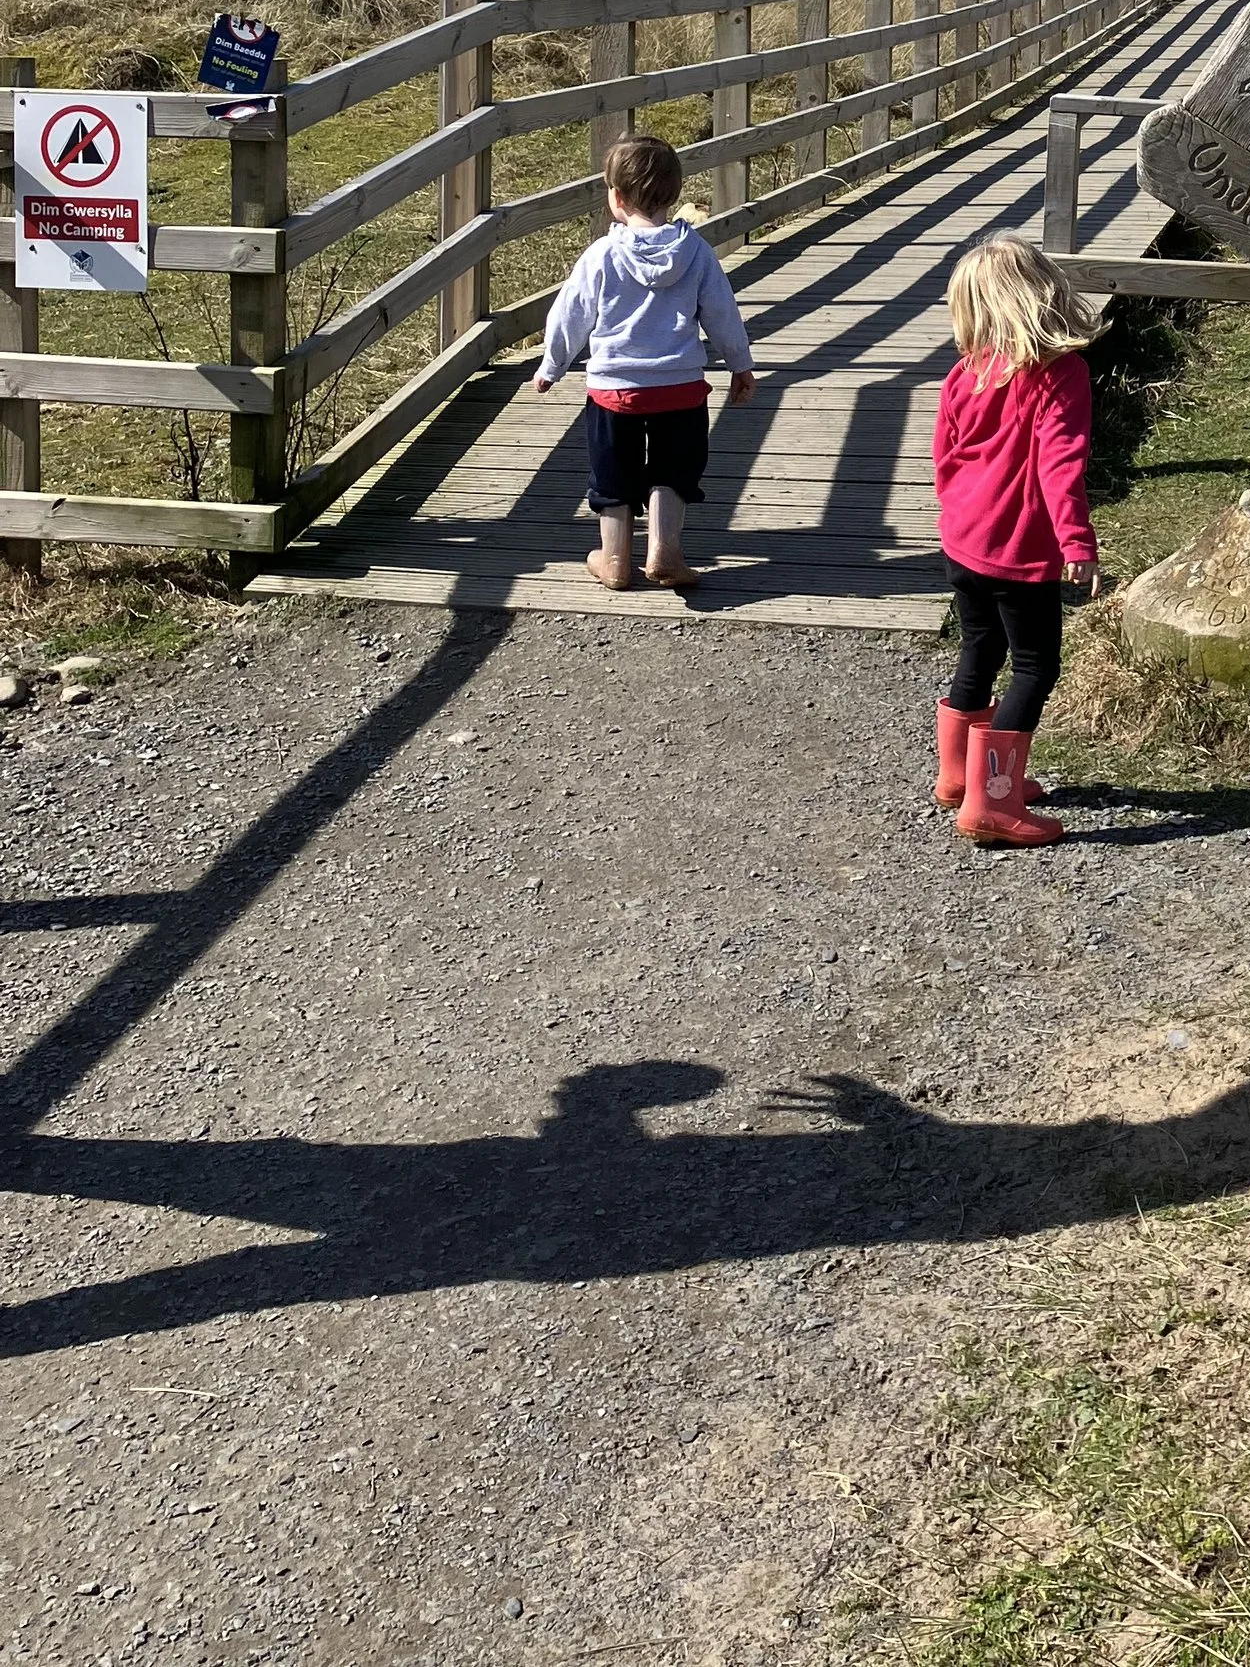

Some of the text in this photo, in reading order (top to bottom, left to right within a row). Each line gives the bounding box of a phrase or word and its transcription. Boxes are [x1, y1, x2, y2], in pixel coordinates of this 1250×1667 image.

[215, 36, 233, 50] Dim
[234, 43, 267, 60] Baeddu
[212, 55, 225, 66] No
[226, 60, 259, 79] Fouling
[31, 201, 133, 220] Dim Gwersylla
[38, 221, 125, 240] No Camping
